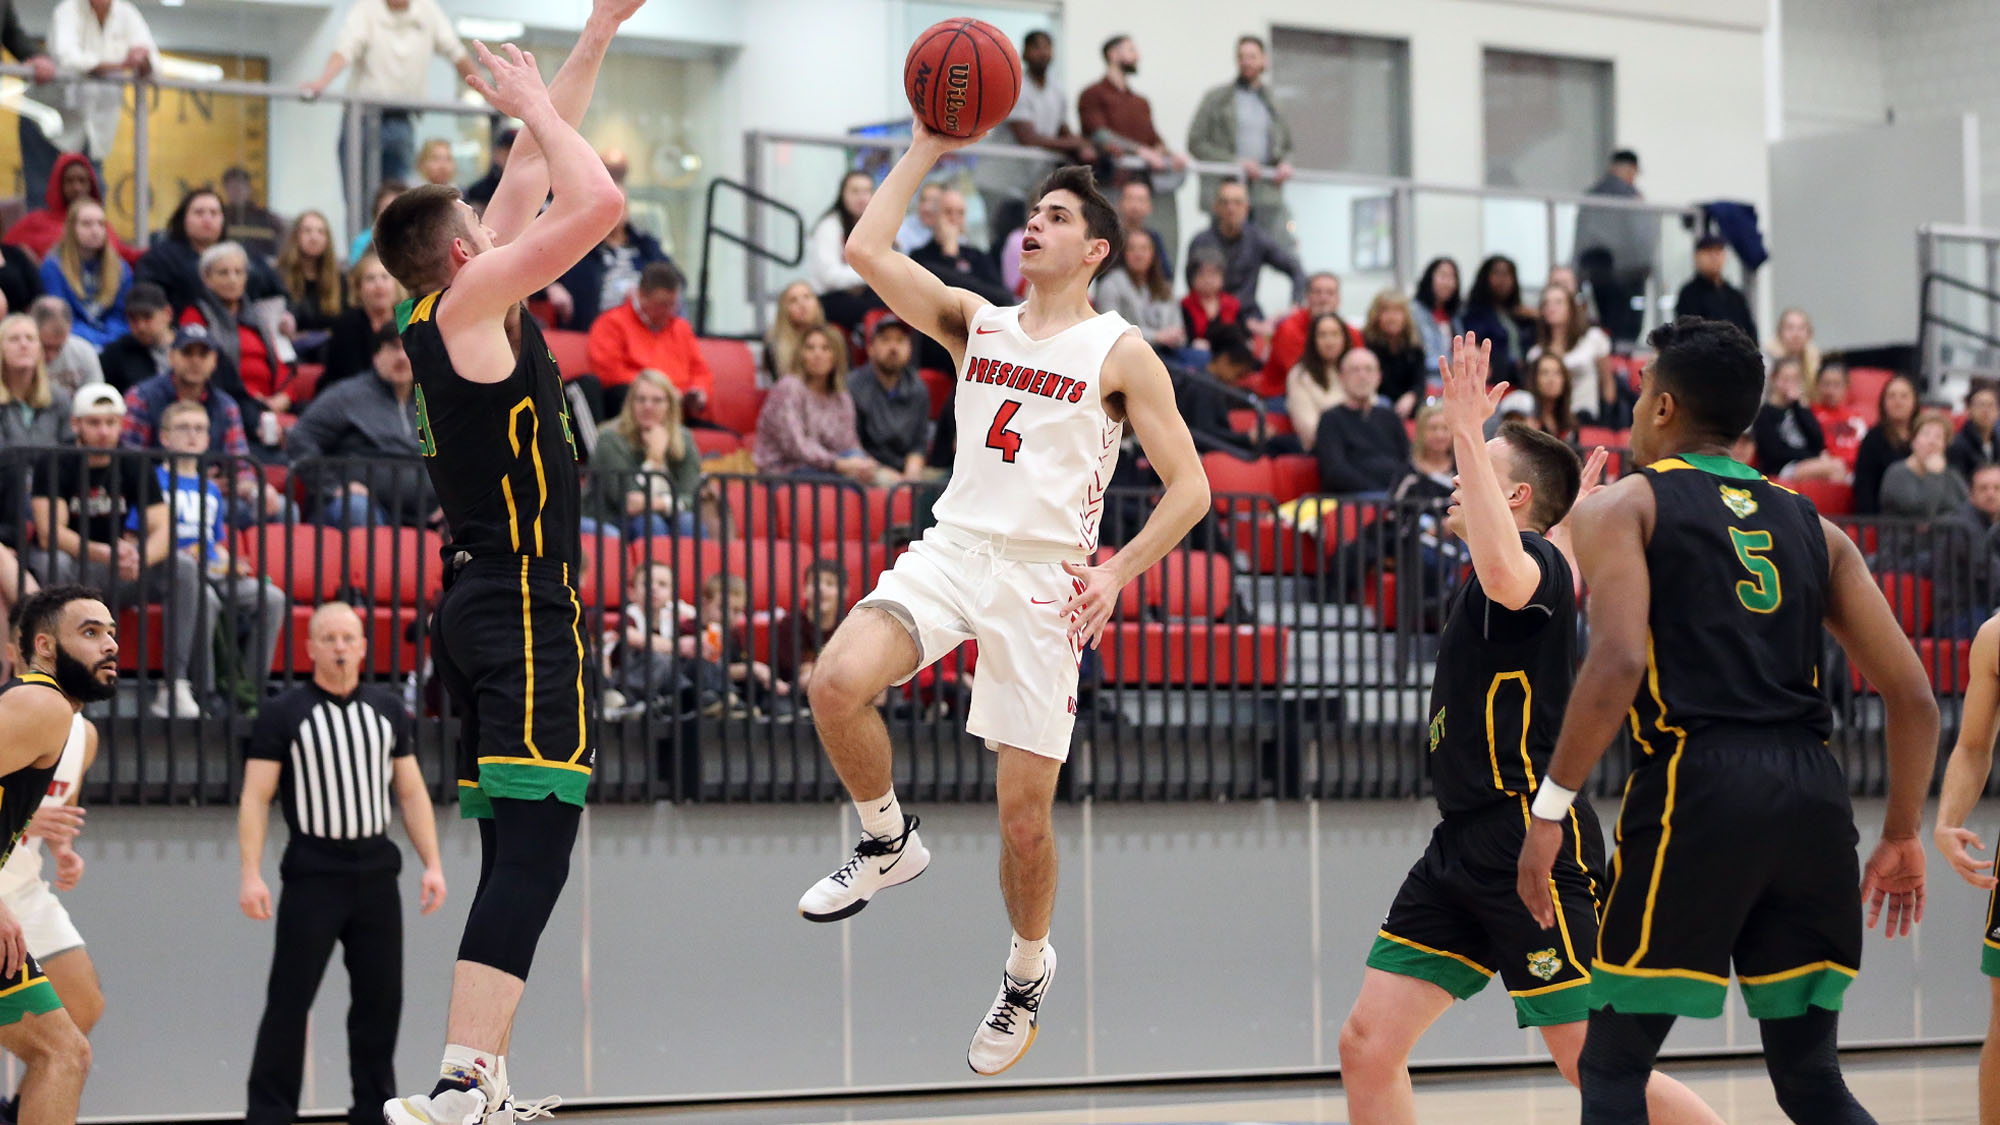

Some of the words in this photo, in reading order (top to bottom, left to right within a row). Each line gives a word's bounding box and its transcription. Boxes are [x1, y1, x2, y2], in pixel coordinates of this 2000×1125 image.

[946, 63, 969, 132] Wilson
[965, 356, 1087, 403] PRESIDENTS
[985, 399, 1022, 464] 4
[1728, 526, 1782, 613] 5
